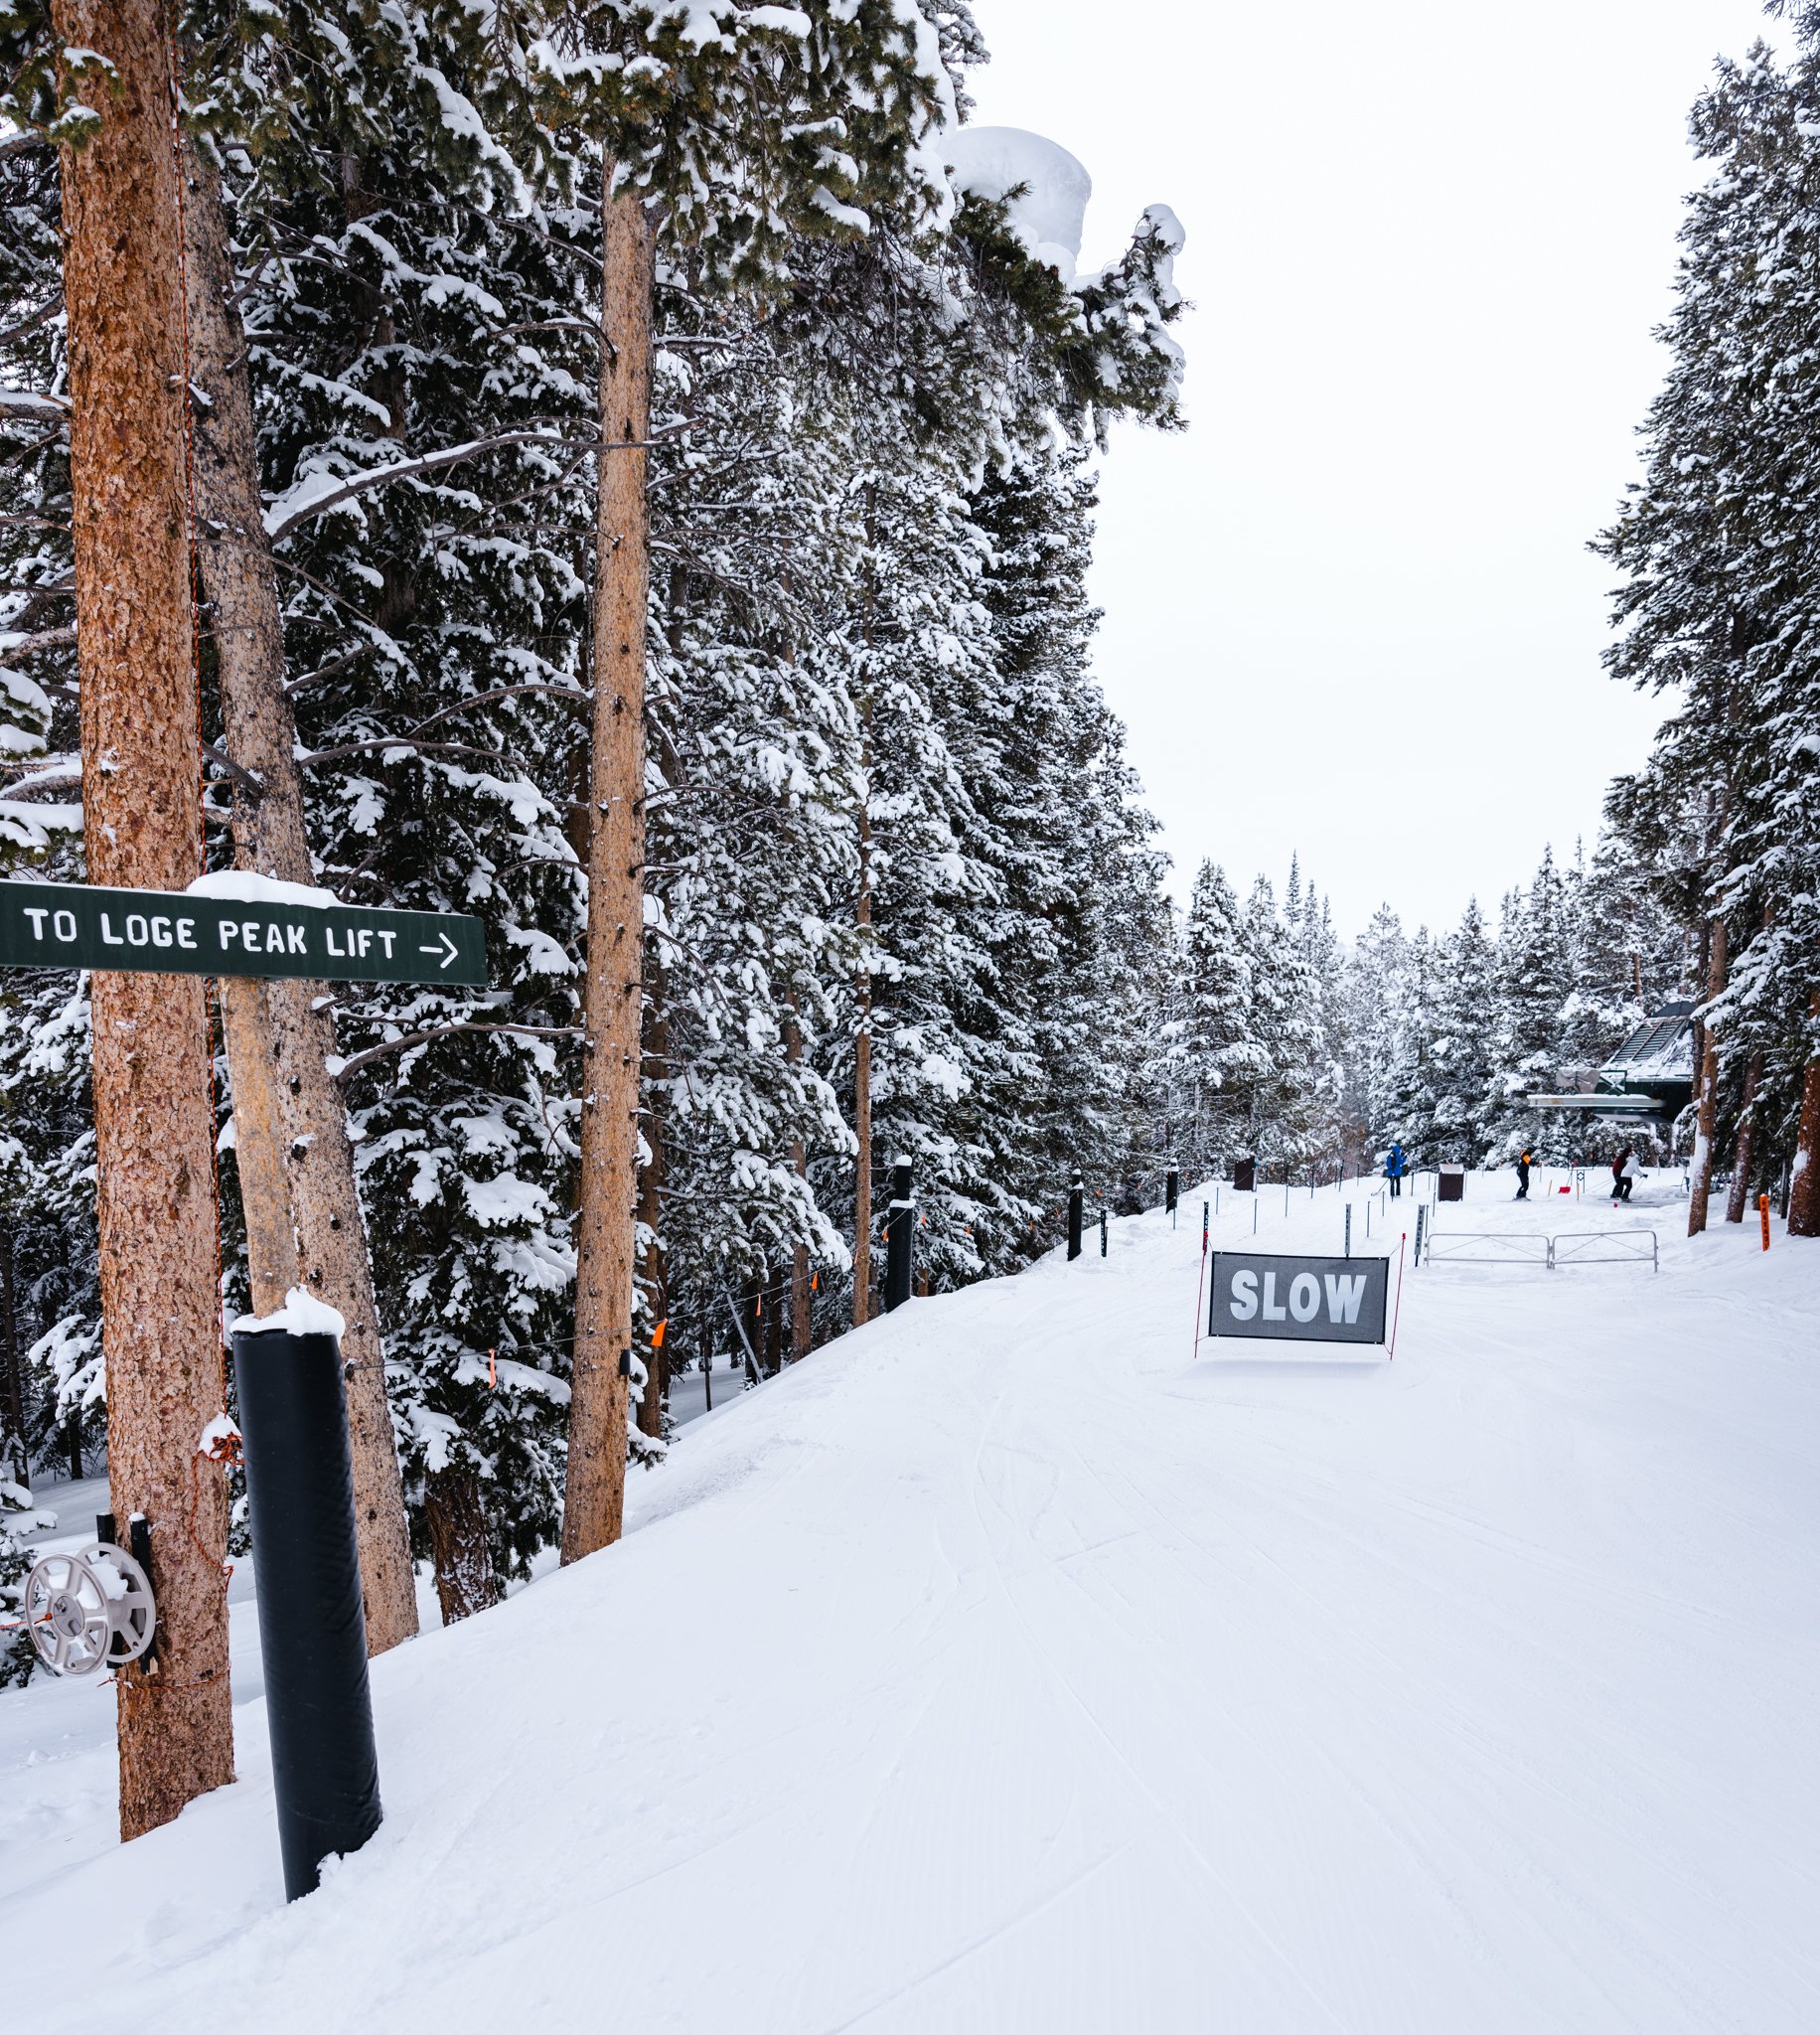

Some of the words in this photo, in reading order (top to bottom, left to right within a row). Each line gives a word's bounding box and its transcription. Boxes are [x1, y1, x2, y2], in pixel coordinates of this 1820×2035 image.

[23, 907, 77, 942] TO
[100, 912, 198, 949] LOGE
[219, 920, 307, 955] PEAK
[326, 927, 397, 960] LIFT
[1229, 1269, 1368, 1325] SLOW
